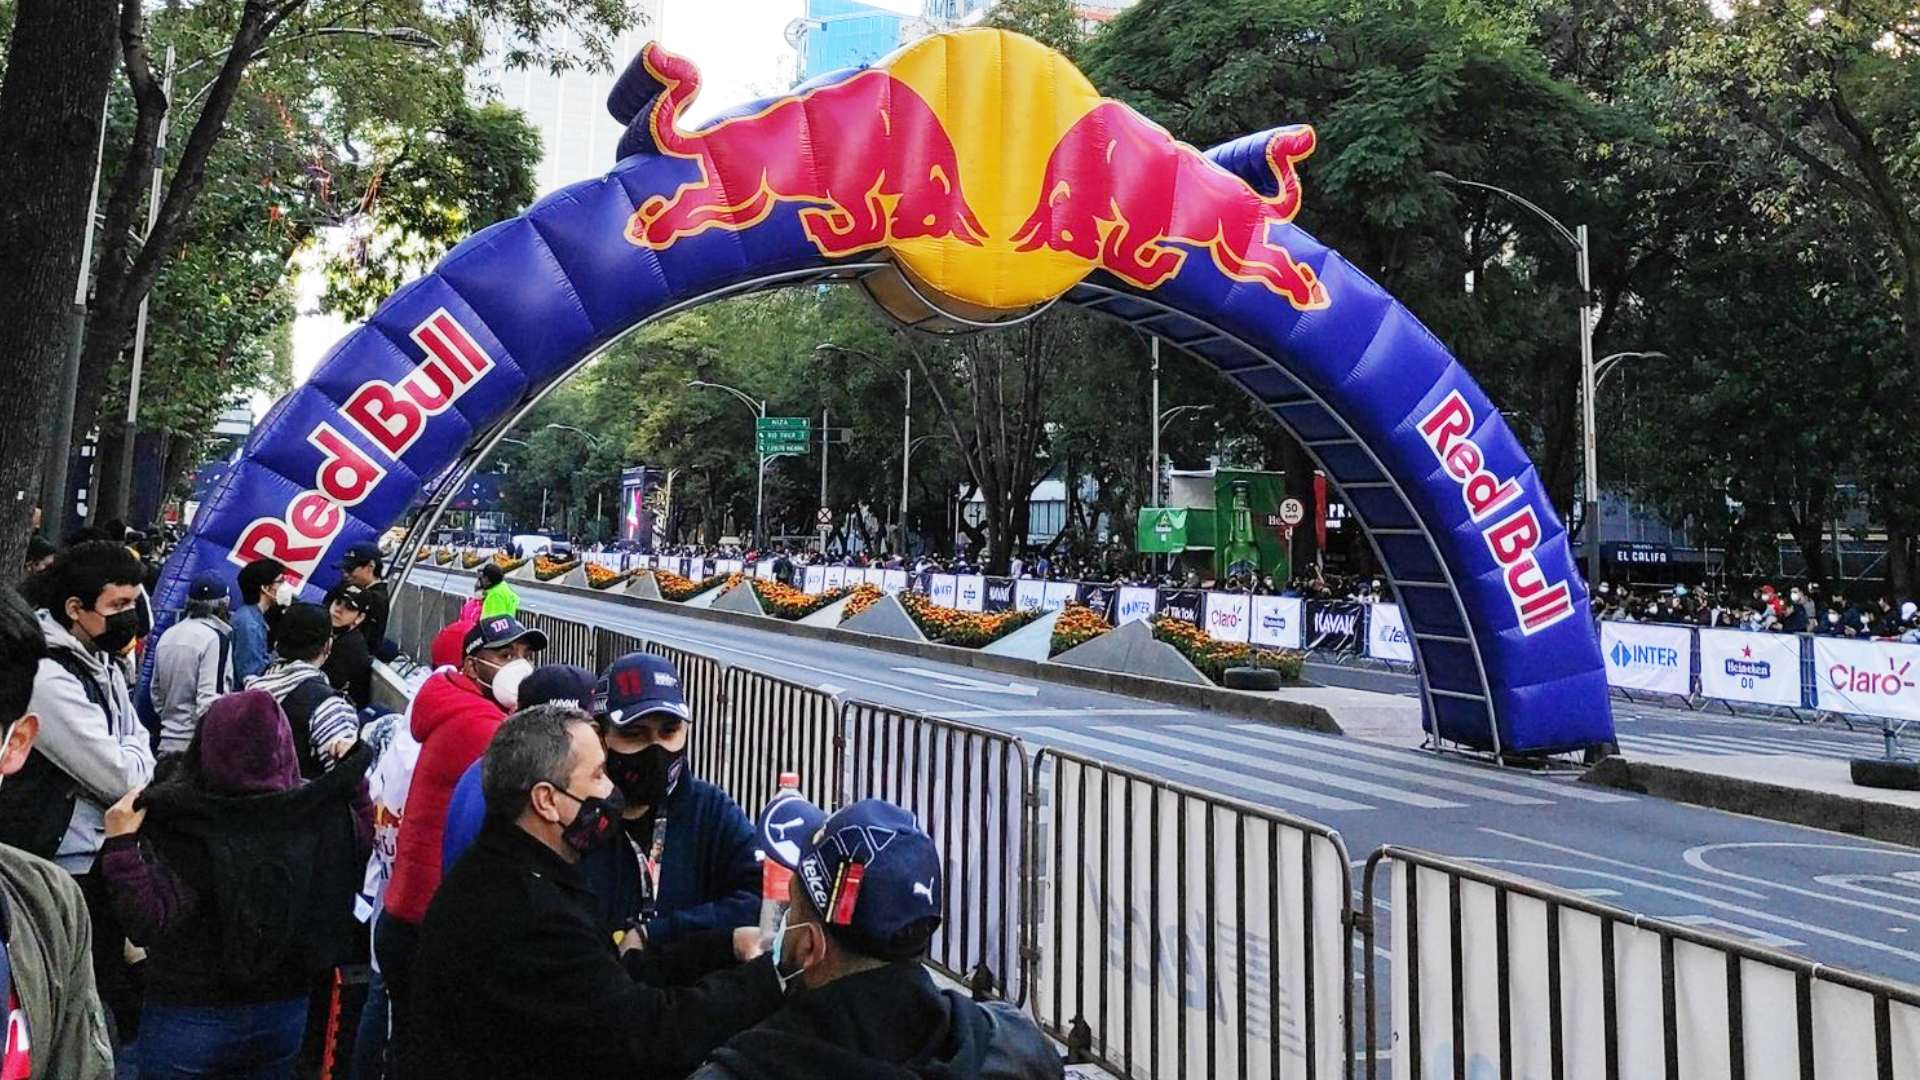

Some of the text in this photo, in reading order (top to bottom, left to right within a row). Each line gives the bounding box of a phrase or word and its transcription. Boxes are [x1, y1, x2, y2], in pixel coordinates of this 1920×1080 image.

[229, 308, 495, 586] Red Bull
[1285, 503, 1298, 512] 50
[1417, 390, 1574, 635] Red Bull
[1617, 551, 1667, 563] EL CALIFA
[1132, 600, 1150, 613] INTER
[1211, 609, 1238, 628] Claro
[1314, 609, 1355, 635] KAVAK
[1633, 644, 1678, 668] INTER
[1726, 659, 1768, 676] Heineken
[1829, 662, 1902, 696] Claro
